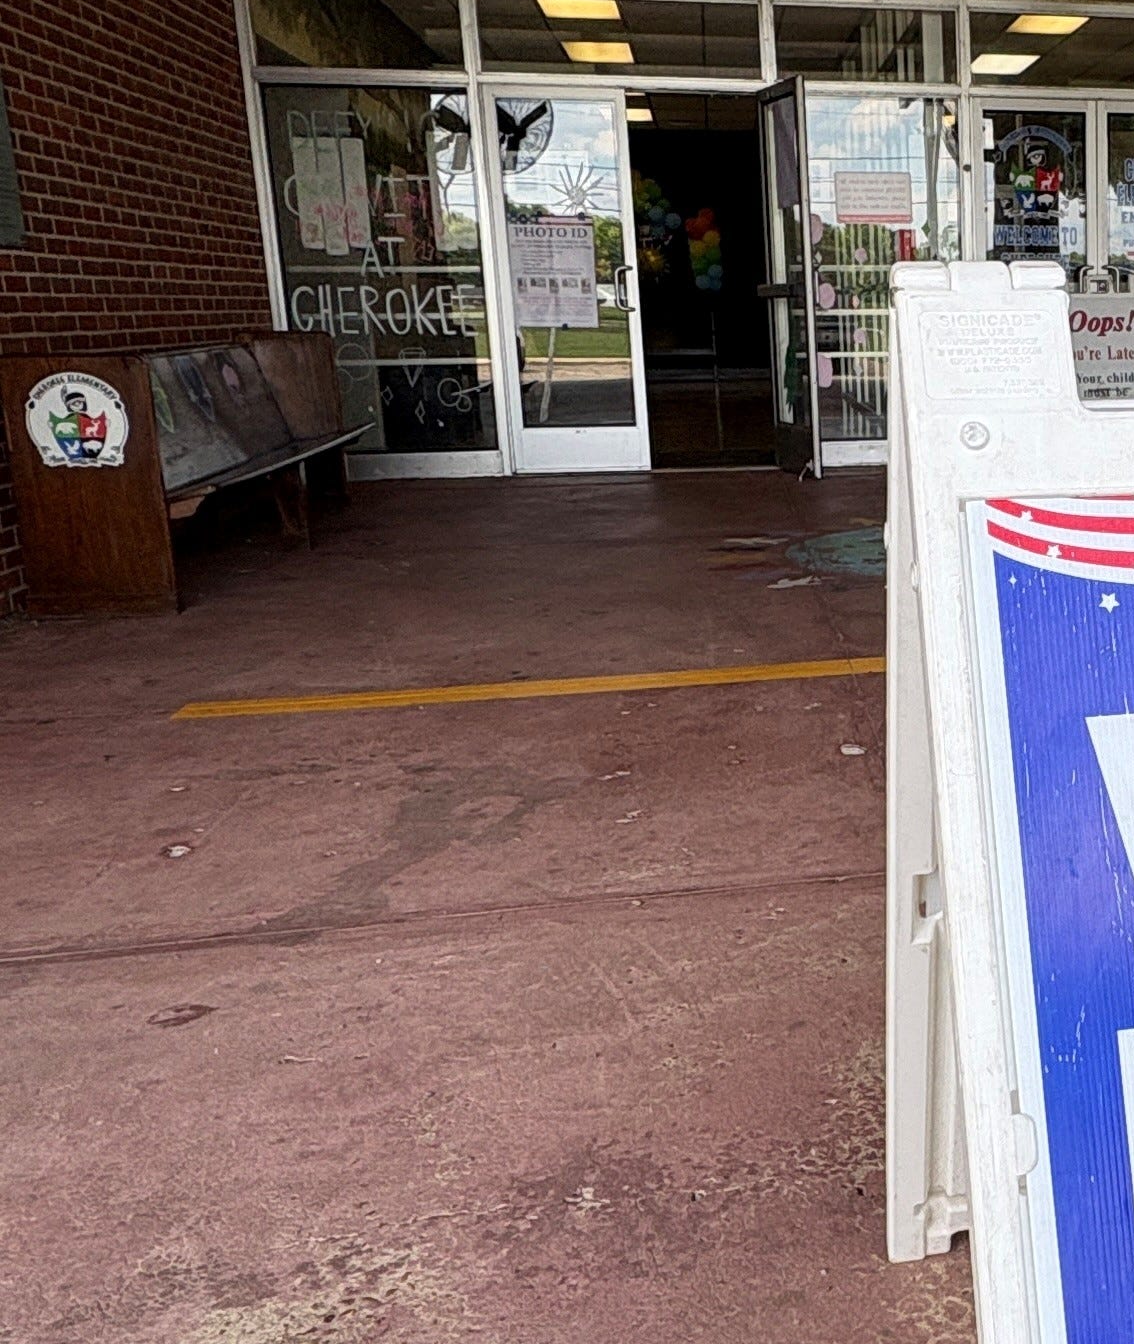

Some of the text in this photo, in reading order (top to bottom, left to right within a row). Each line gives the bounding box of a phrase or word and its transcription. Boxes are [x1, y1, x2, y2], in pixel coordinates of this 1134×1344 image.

[514, 227, 588, 238] PHOTO ID
[994, 225, 1078, 246] WELCOME TO
[361, 236, 406, 277] AT
[291, 284, 479, 338] CHEROKEE
[1073, 345, 1102, 360] u're
[1107, 371, 1134, 383] child
